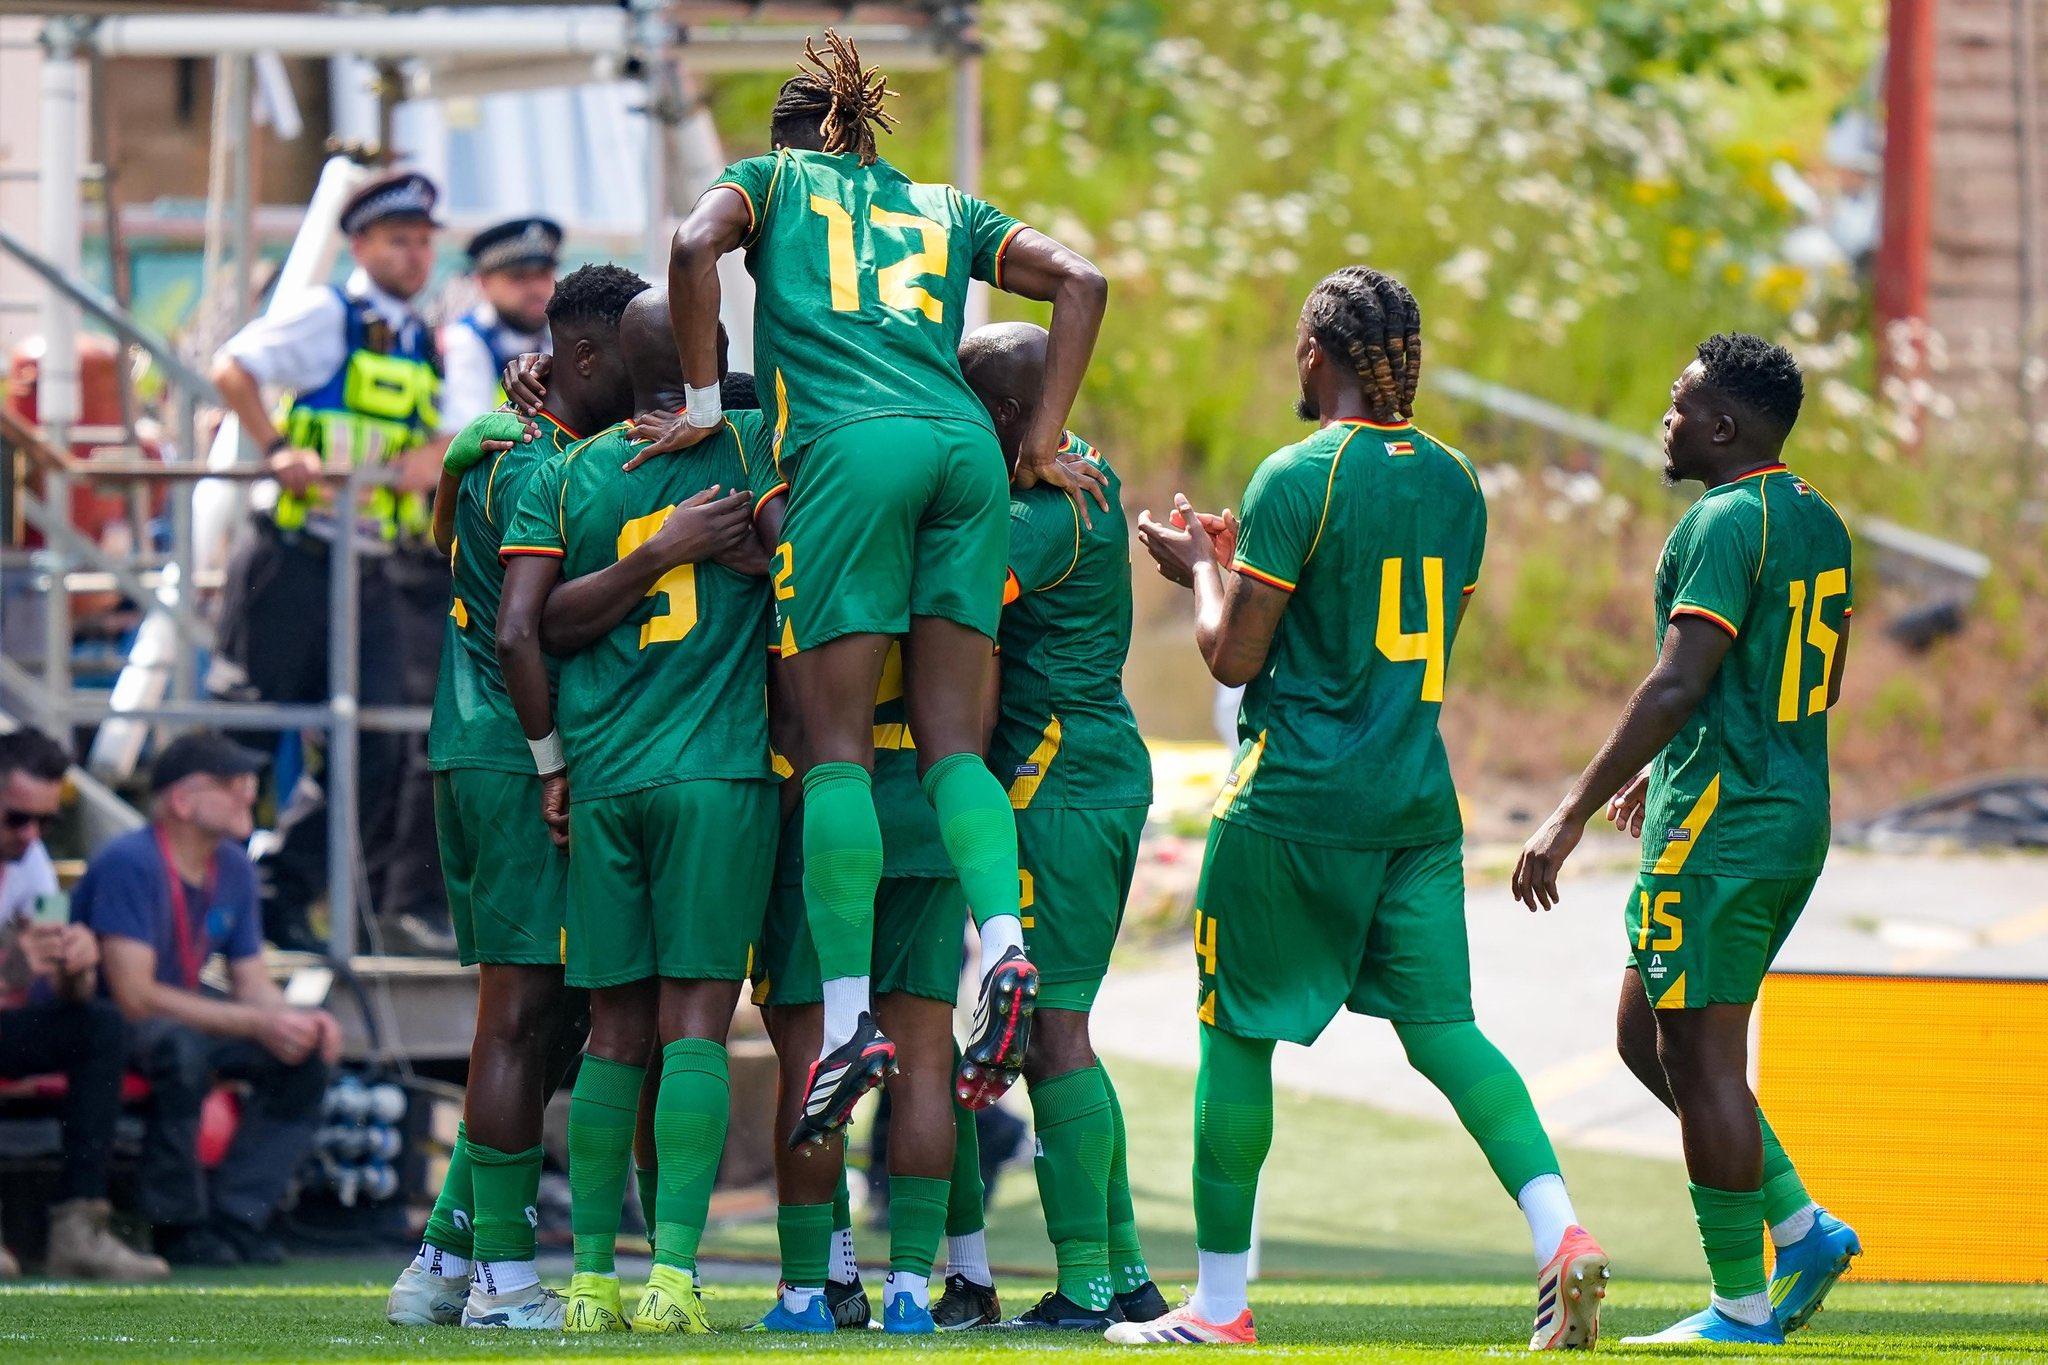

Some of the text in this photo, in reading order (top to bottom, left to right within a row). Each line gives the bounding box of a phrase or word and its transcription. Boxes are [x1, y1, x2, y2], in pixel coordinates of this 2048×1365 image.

[810, 194, 949, 323] 12
[1376, 556, 1445, 703] 4
[1777, 567, 1847, 723] 15
[1195, 909, 1217, 975] 4
[1638, 891, 1683, 951] 15
